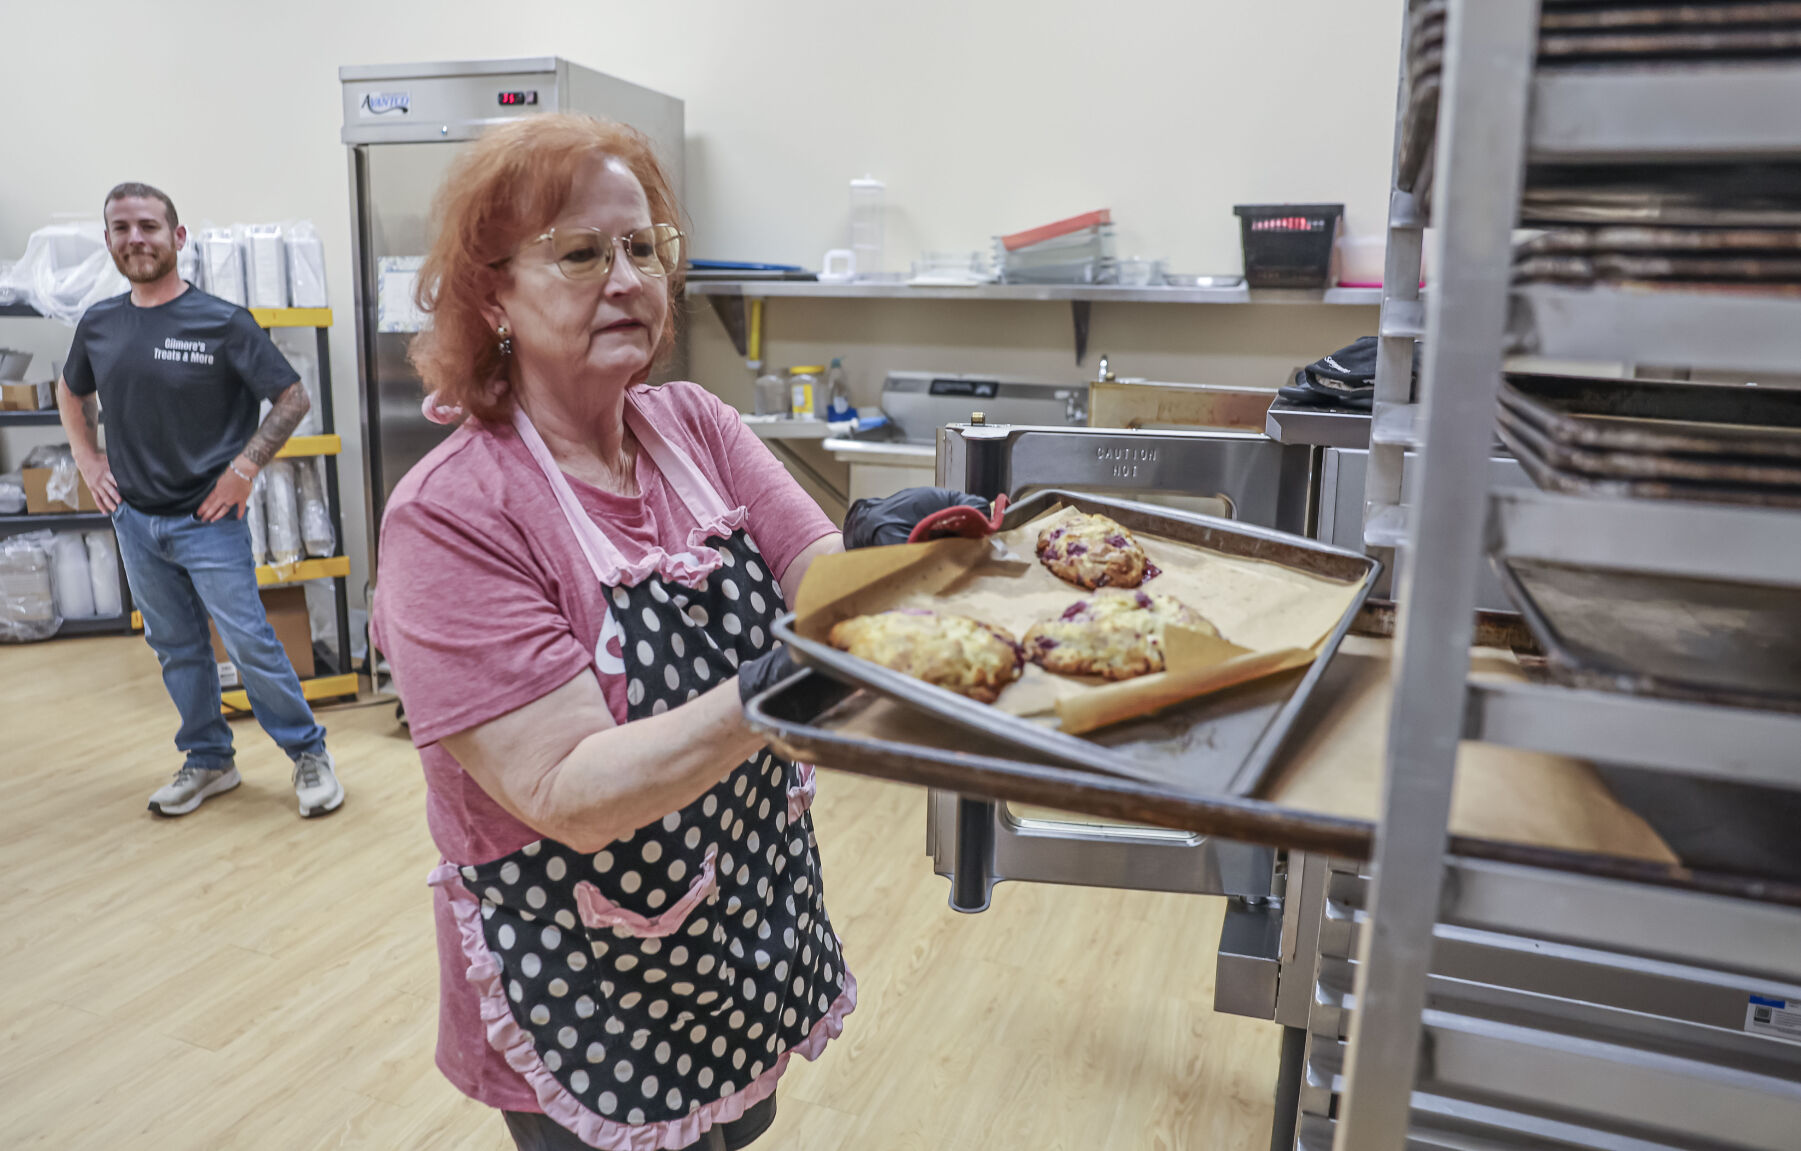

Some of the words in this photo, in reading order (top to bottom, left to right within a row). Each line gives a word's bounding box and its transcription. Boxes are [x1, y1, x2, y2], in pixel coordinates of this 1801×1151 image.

[165, 337, 206, 352] Gilmore's
[154, 347, 181, 361] Treats
[190, 351, 214, 365] More
[1097, 447, 1157, 461] CAUTION
[1113, 465, 1137, 478] HOT
